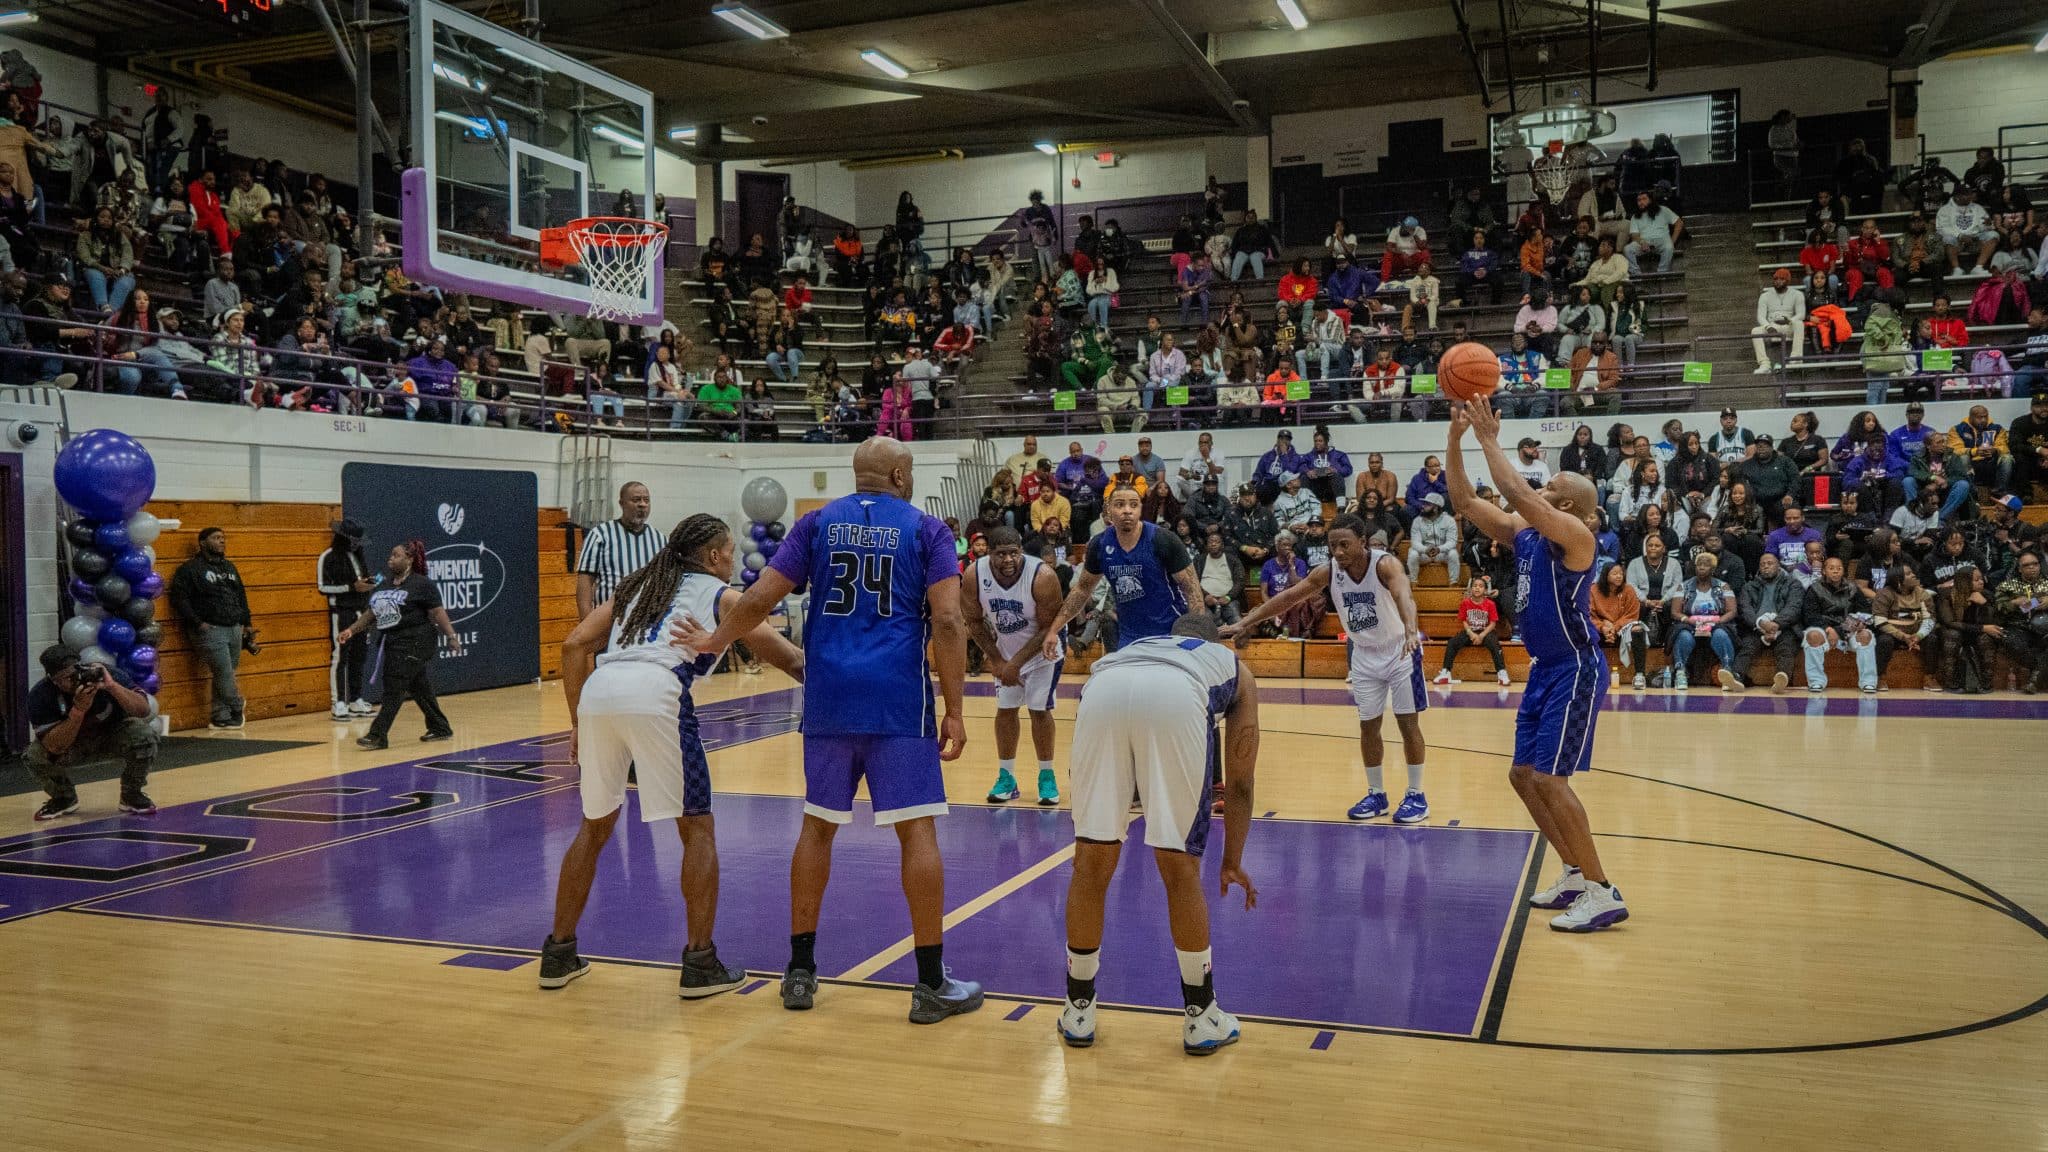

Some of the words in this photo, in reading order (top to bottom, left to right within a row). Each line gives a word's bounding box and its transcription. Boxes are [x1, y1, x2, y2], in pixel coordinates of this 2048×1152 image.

[333, 420, 366, 433] SEC-11
[828, 523, 901, 550] STREETS
[436, 580, 484, 610] NDSET
[823, 551, 894, 617] 34
